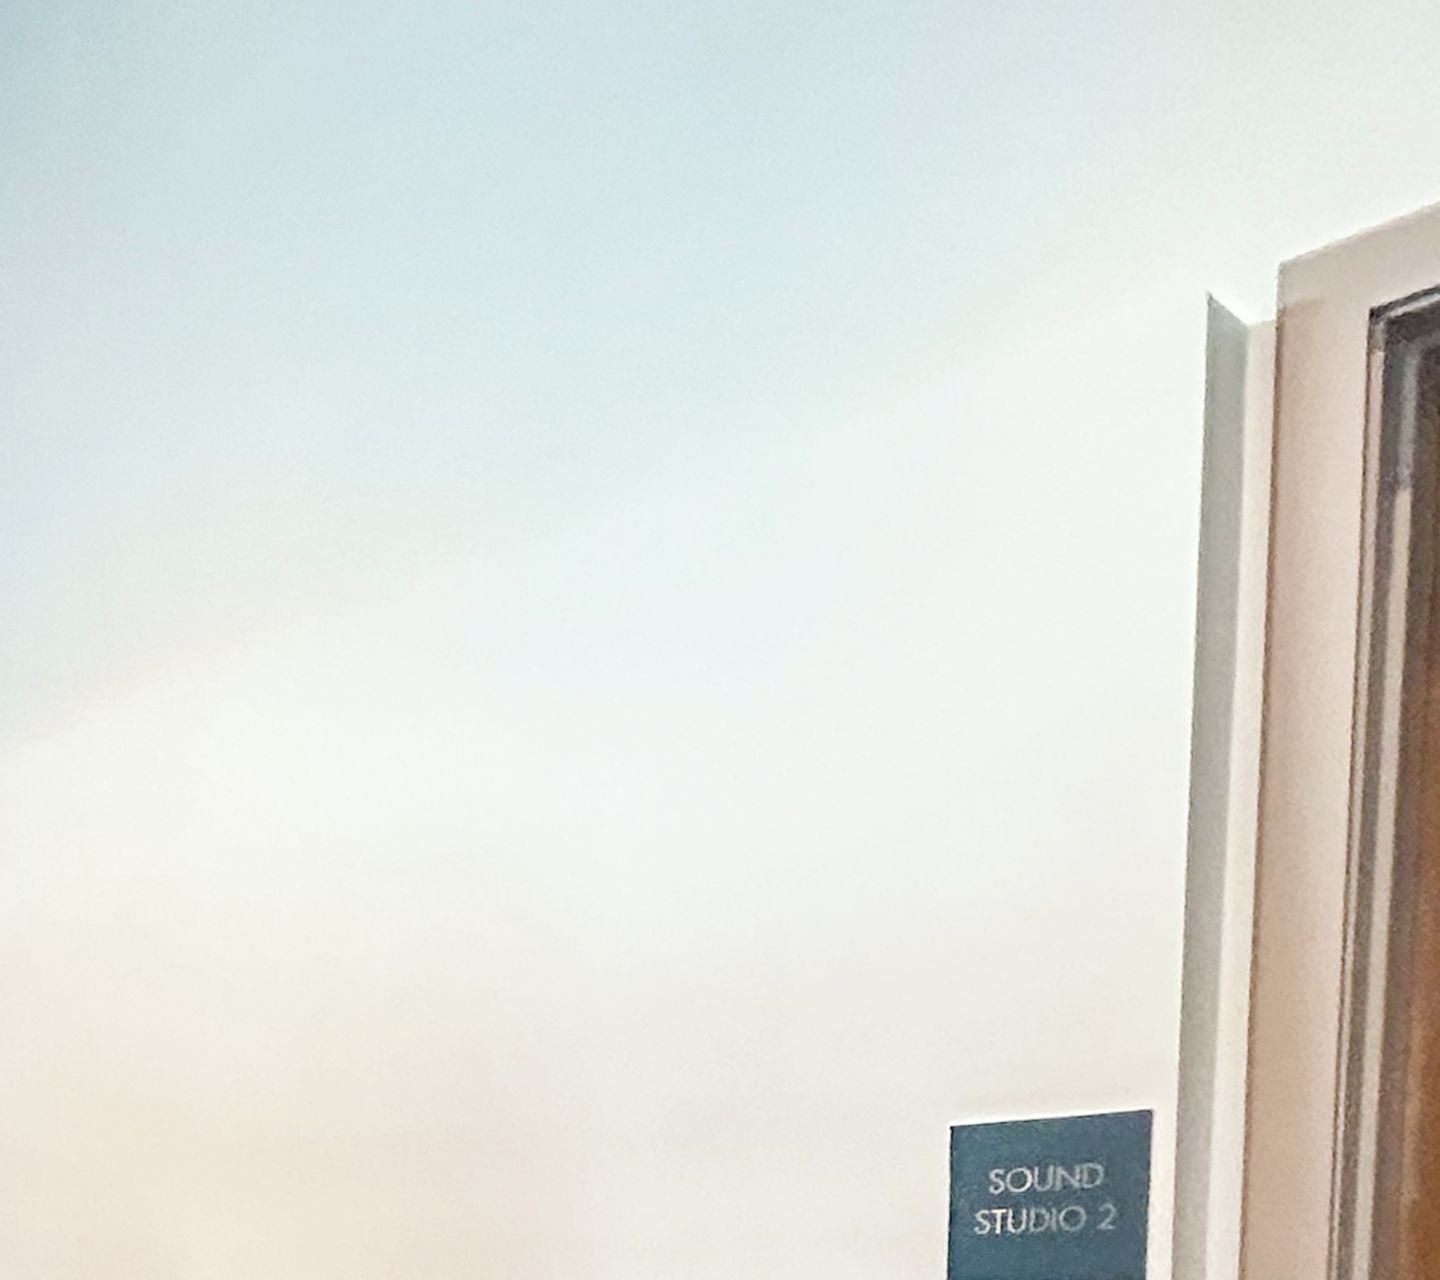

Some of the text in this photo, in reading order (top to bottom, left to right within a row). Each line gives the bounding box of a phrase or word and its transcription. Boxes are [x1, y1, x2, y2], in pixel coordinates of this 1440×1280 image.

[988, 1162, 1105, 1195] SOUND
[973, 1203, 1118, 1235] STUDIO 2
